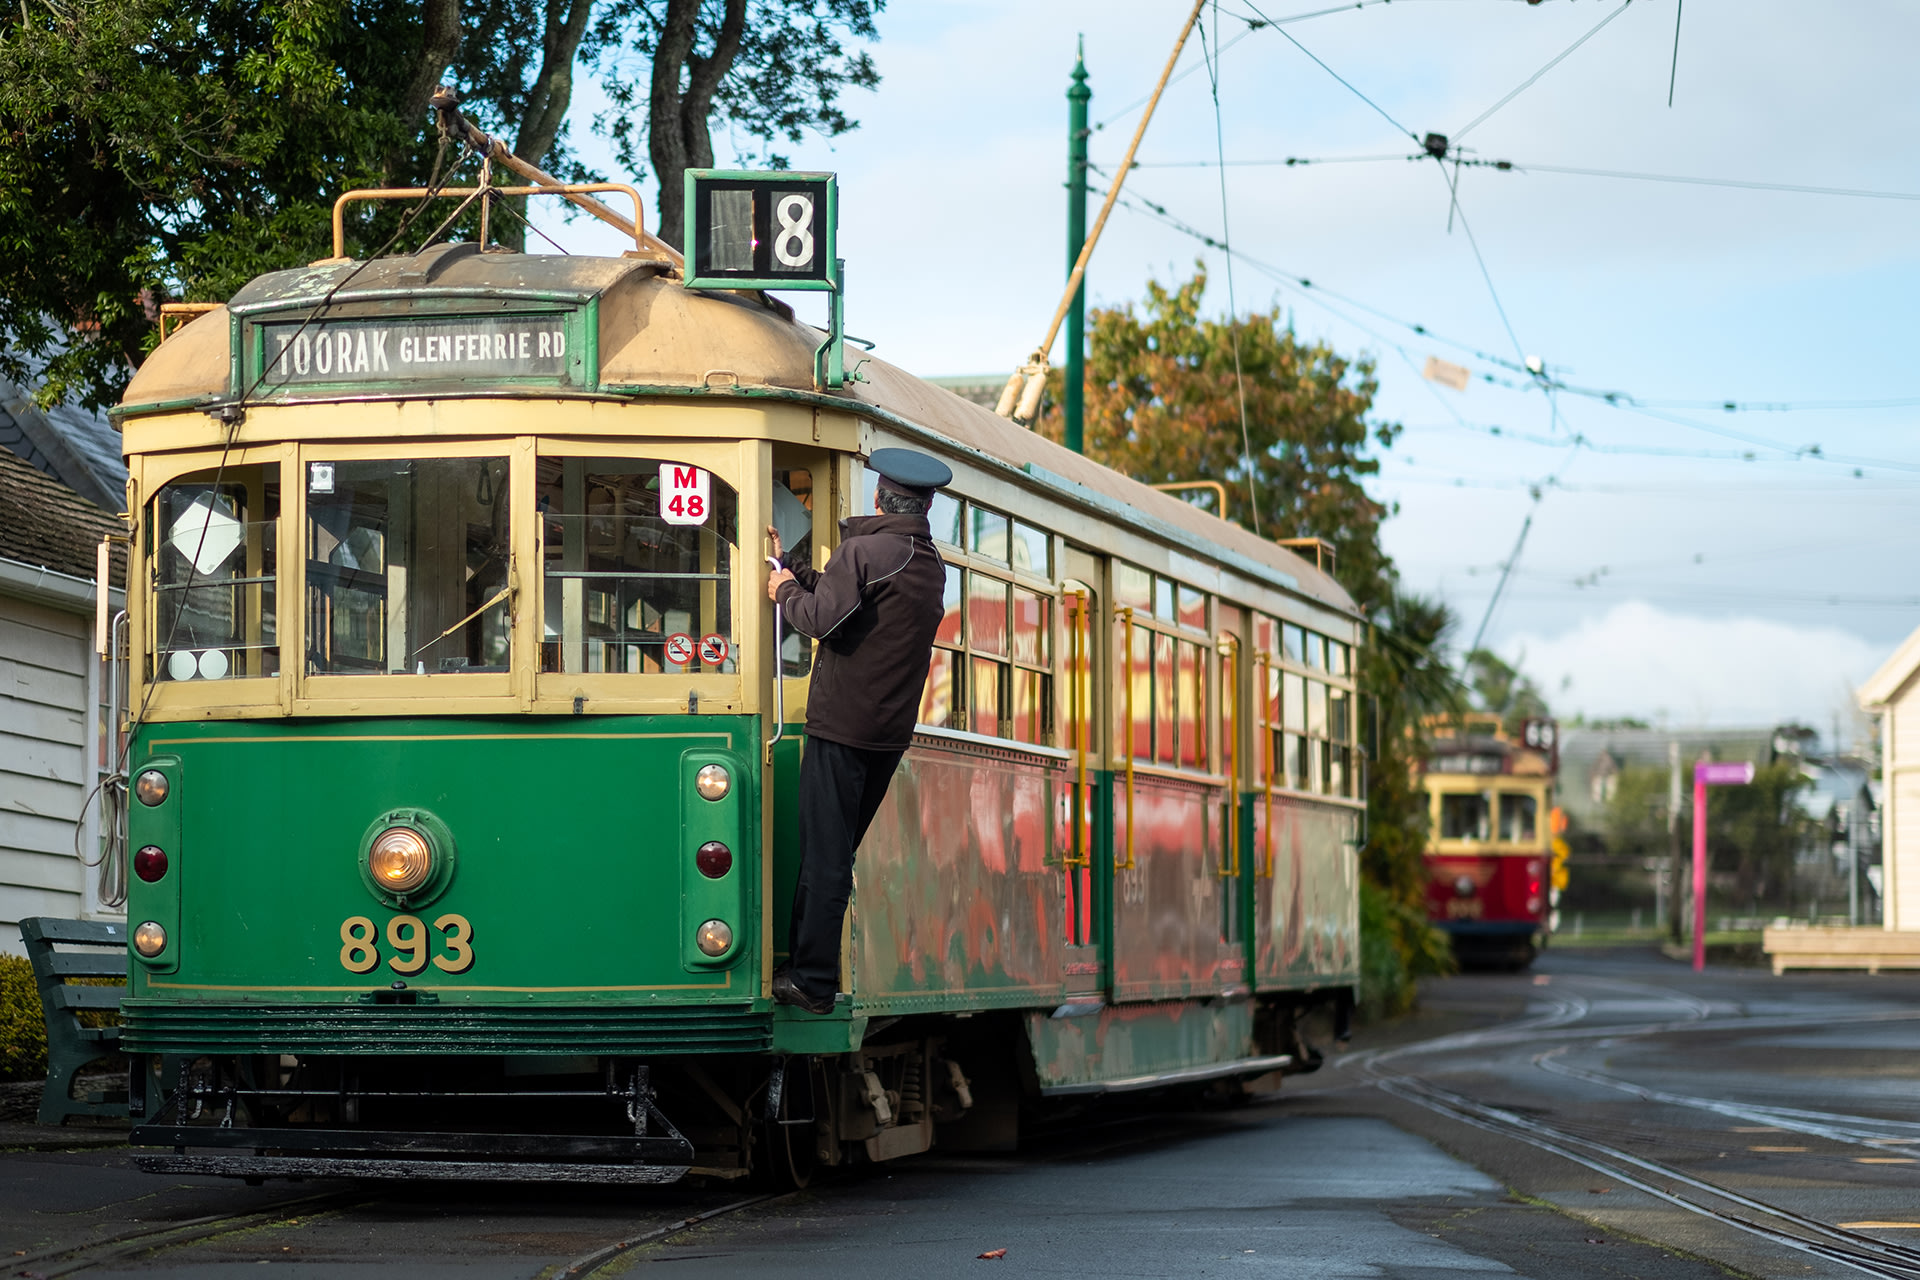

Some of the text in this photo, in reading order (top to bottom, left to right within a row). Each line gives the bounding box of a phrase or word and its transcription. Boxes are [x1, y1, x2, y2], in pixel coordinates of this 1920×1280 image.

[774, 194, 814, 267] 8
[276, 330, 566, 376] TOORAK GLENFERRIE RD
[673, 467, 698, 489] M
[667, 494, 705, 518] 48
[339, 913, 476, 977] 893
